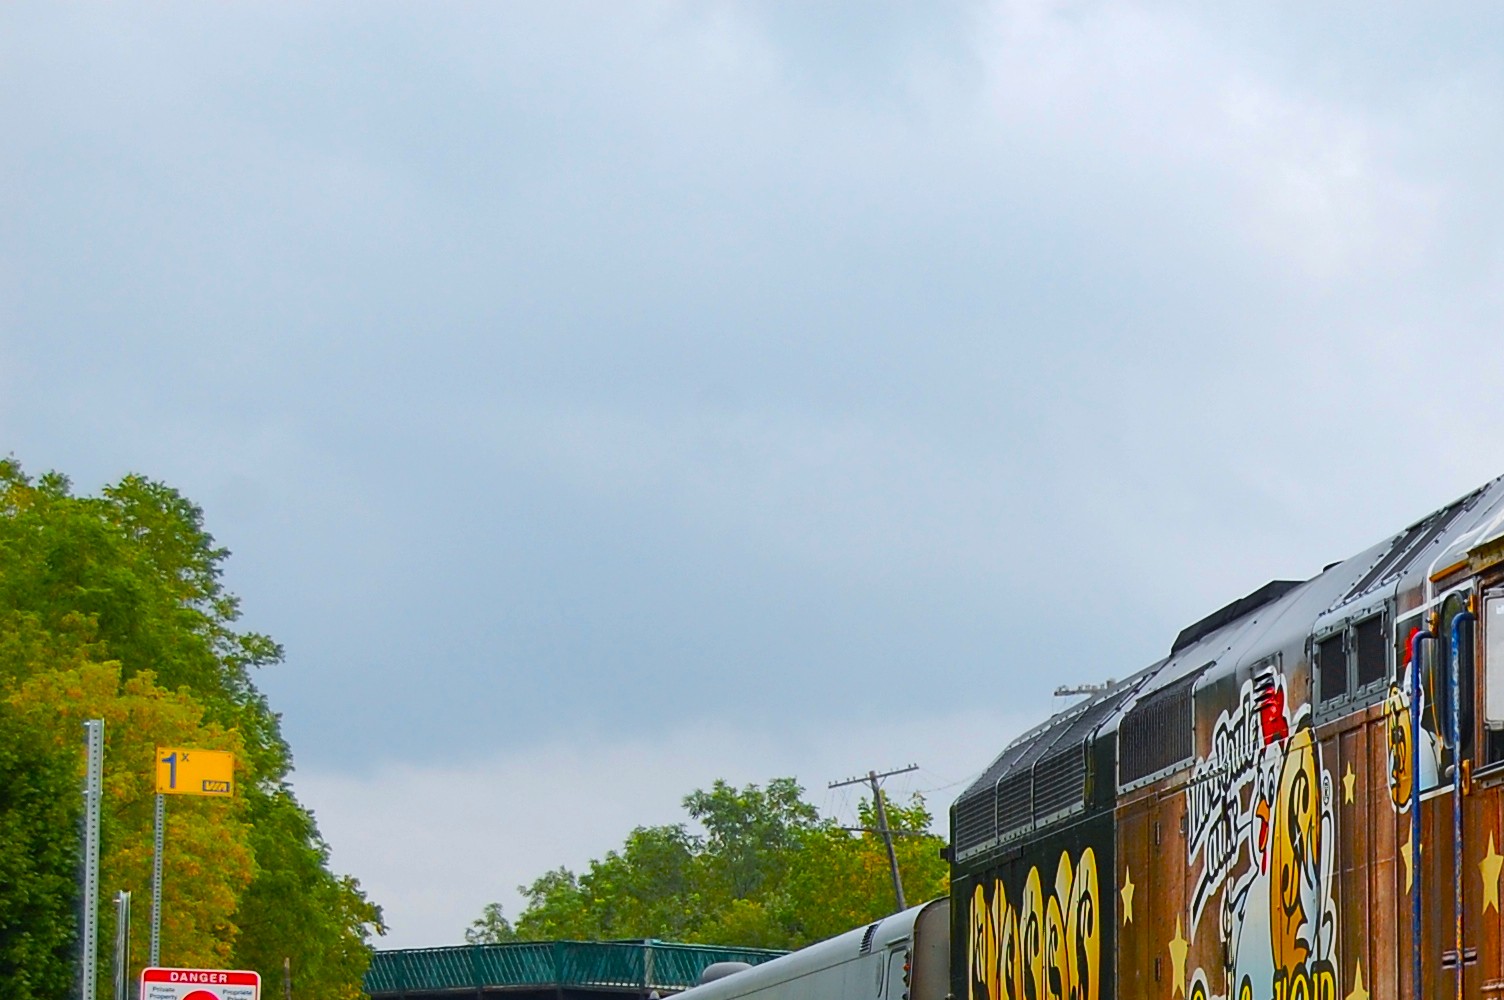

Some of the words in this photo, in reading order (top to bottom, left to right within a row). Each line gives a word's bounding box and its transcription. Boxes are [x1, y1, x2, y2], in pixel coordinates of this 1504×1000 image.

[162, 752, 177, 789] 1
[204, 780, 229, 792] VIA
[170, 972, 228, 983] DANGER
[149, 993, 178, 1000] Property
